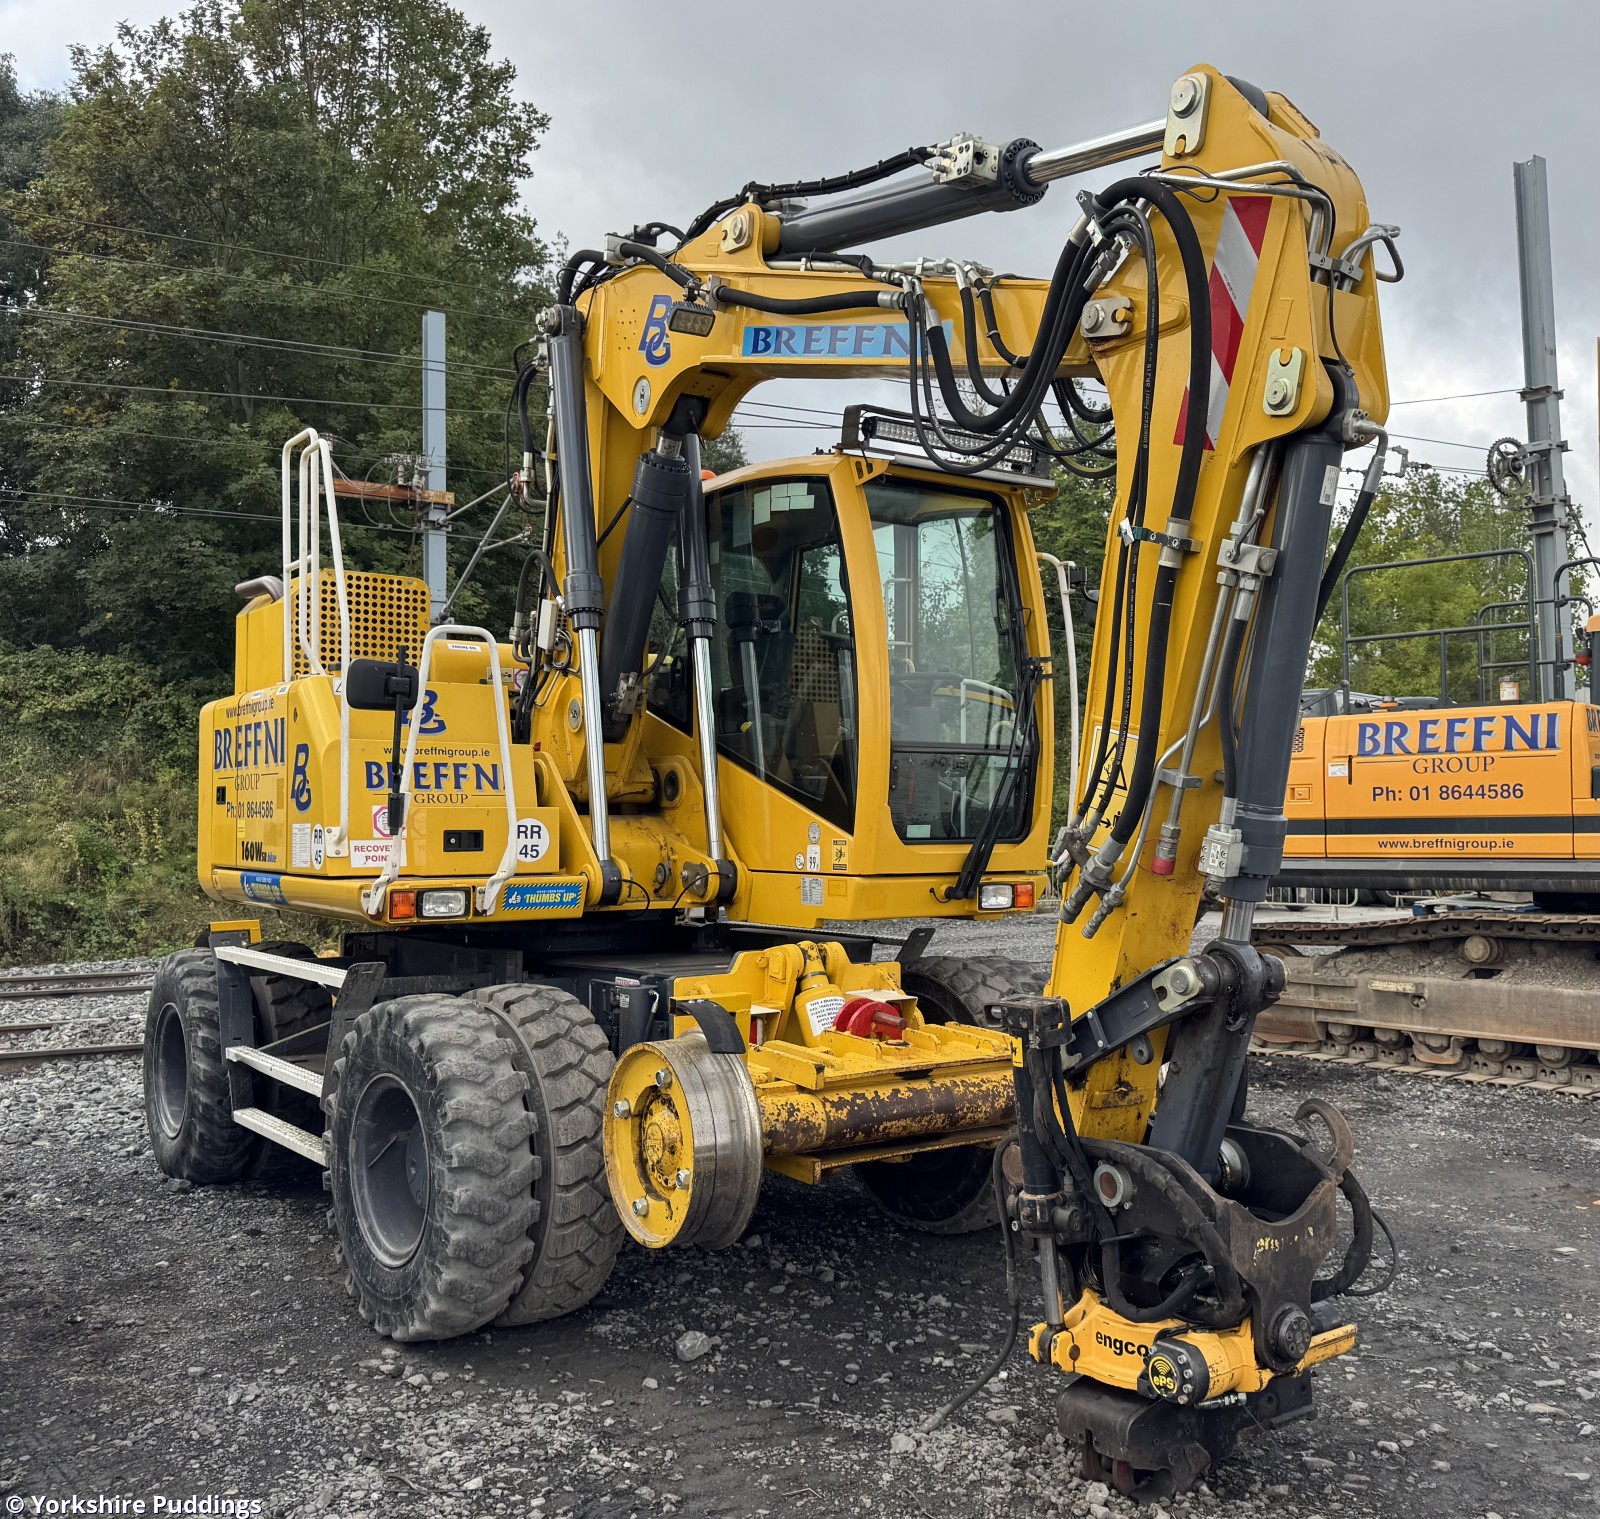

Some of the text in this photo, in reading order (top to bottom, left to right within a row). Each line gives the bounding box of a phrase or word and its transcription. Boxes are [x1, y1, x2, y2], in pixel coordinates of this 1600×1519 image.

[751, 326, 932, 355] BREFFN
[1357, 713, 1559, 756] BREFFNI
[214, 717, 286, 770] BREFFNI
[1412, 756, 1495, 774] GROUP
[234, 773, 260, 791] GROUP
[365, 761, 505, 790] BEFFN
[414, 793, 468, 804] GROUP
[1372, 783, 1524, 801] Ph: 01 8644586
[247, 801, 274, 818] 8644586
[314, 829, 323, 844] RR
[517, 825, 542, 839] RR
[519, 844, 540, 858] 45
[1378, 838, 1514, 850] www.breffnigroup.ie
[314, 850, 323, 865] 45
[365, 854, 389, 862] POIN
[1096, 1331, 1149, 1357] engco
